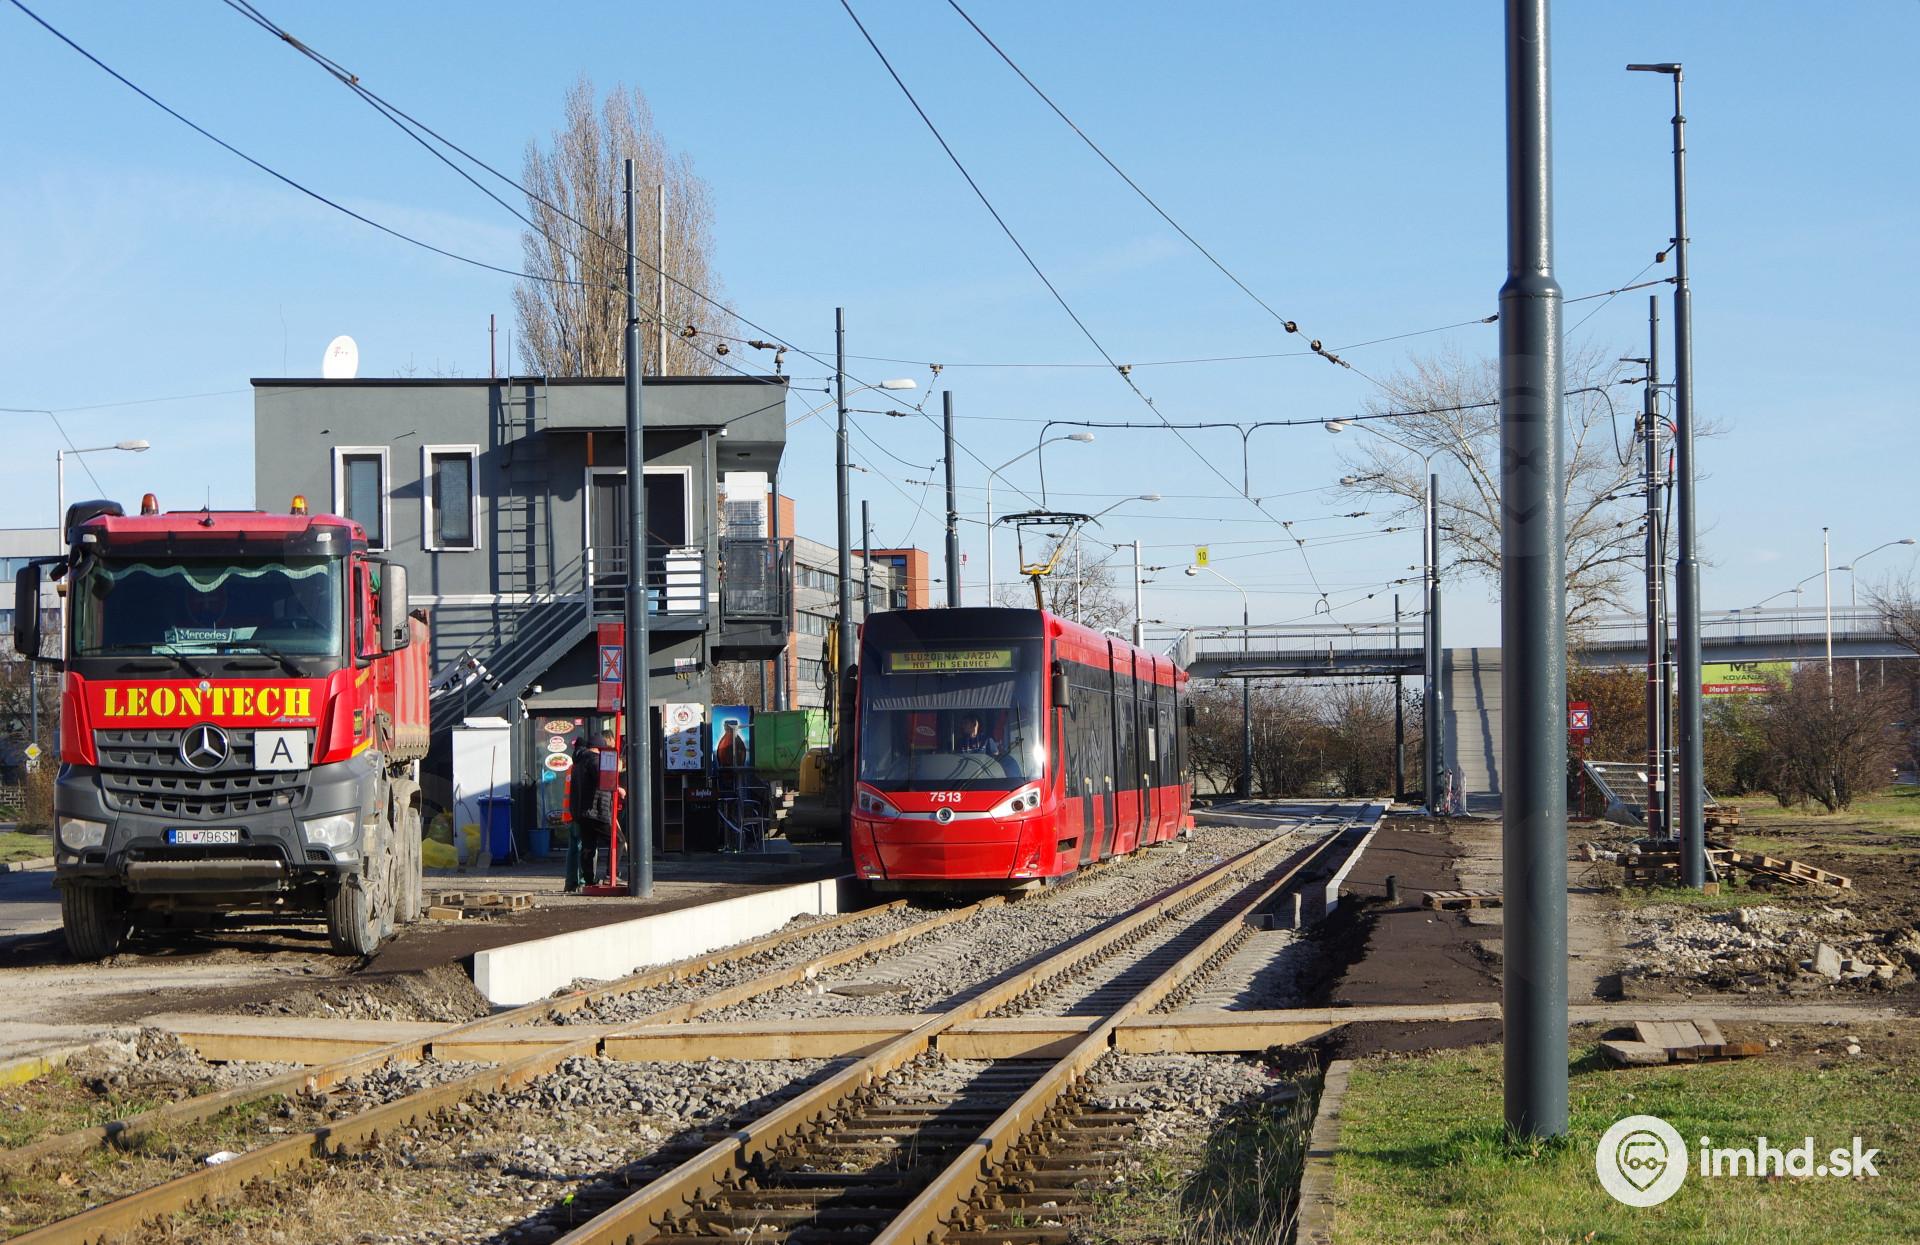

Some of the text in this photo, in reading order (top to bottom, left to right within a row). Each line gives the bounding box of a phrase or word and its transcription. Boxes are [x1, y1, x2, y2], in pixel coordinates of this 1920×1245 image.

[1198, 551, 1207, 561] 10
[180, 629, 227, 640] Mercedes
[963, 650, 999, 660] JAZDA
[912, 659, 990, 669] NOT IN SERVICE
[104, 687, 311, 717] LEONTECH
[271, 737, 293, 764] A
[930, 791, 962, 803] 7513
[177, 831, 192, 843] BL
